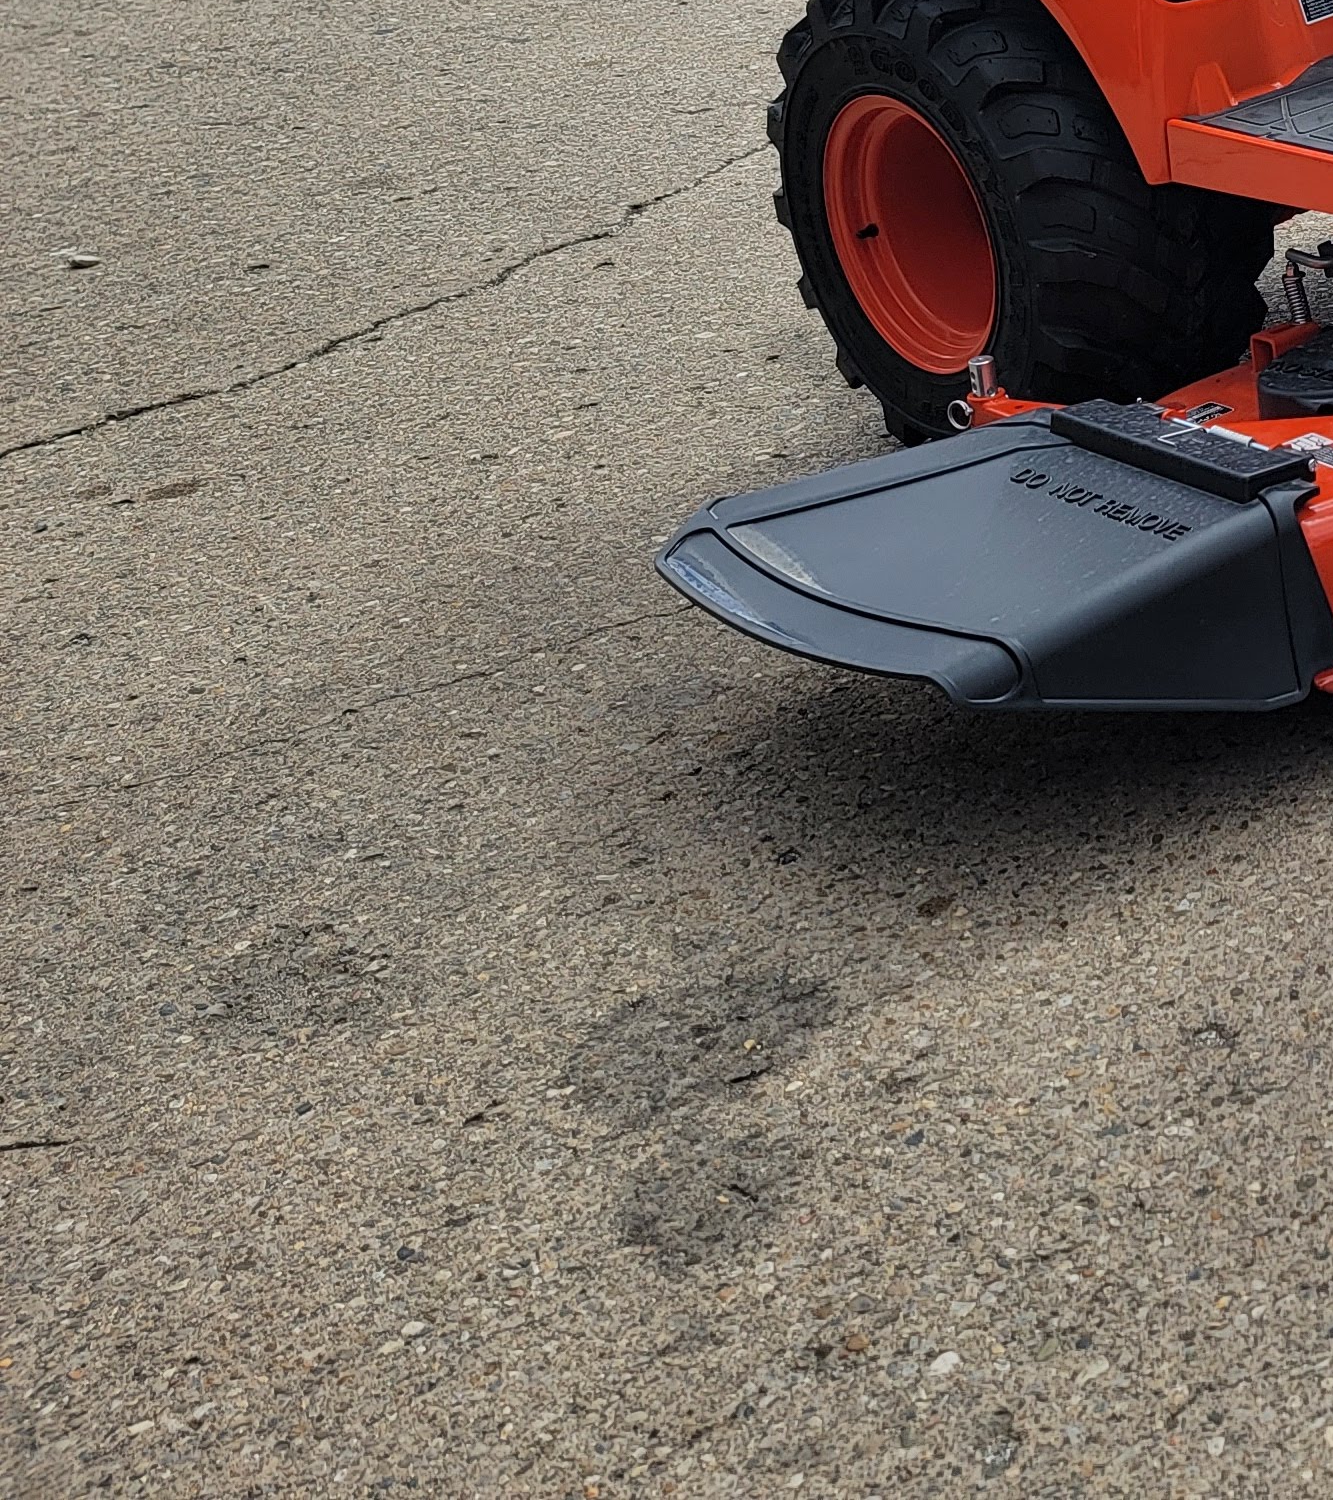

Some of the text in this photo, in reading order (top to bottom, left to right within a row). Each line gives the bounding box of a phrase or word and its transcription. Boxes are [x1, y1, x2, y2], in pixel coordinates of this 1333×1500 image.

[1010, 468, 1194, 542] DO NOT REMOVE
